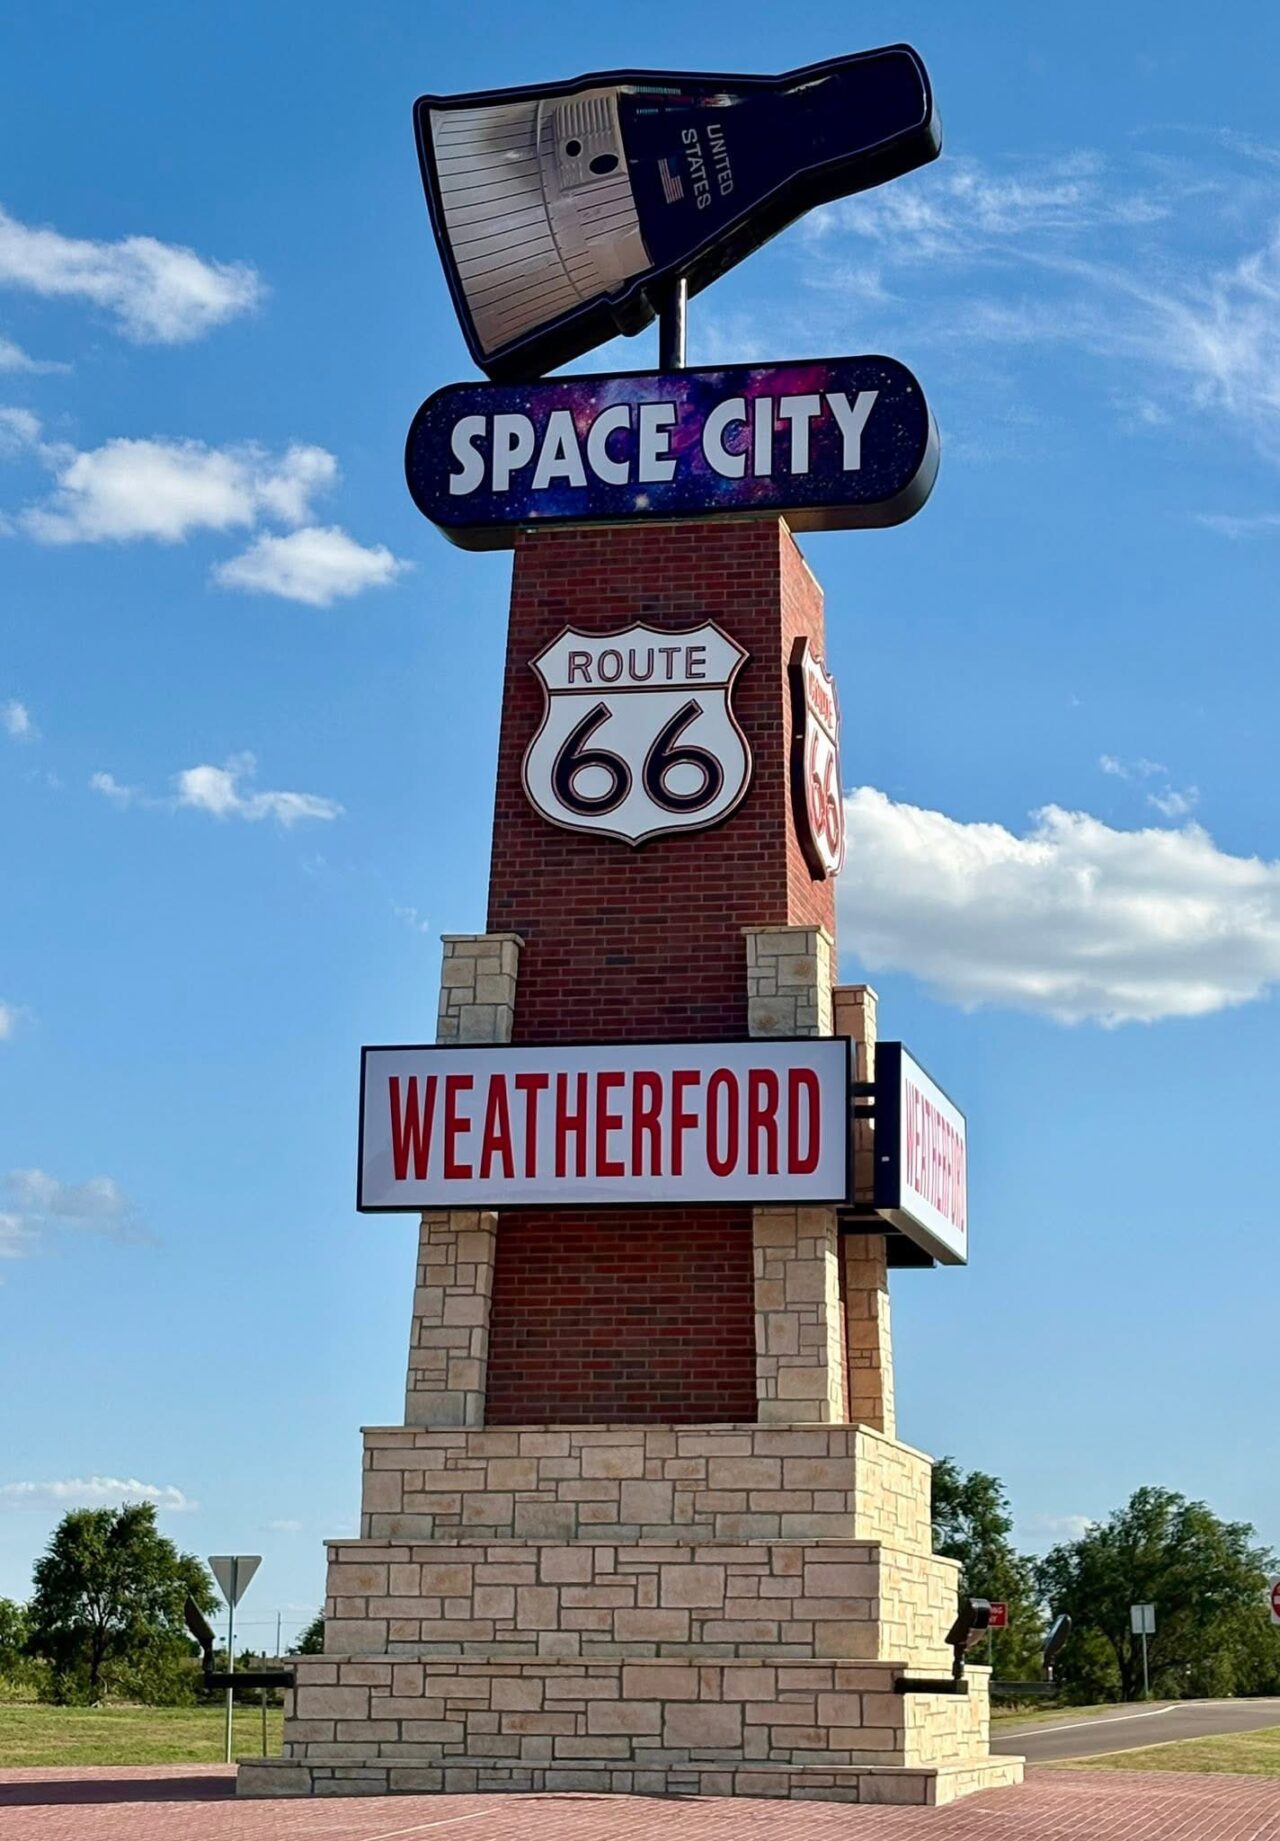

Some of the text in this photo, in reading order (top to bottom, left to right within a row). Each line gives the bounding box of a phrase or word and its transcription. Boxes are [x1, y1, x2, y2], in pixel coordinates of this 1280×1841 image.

[681, 128, 711, 210] STATES
[706, 124, 734, 196] UNITED
[449, 390, 880, 496] SPACE CITY
[568, 646, 706, 684] ROUTE
[551, 698, 725, 817] 66
[388, 1068, 821, 1181] WEATHERFORD
